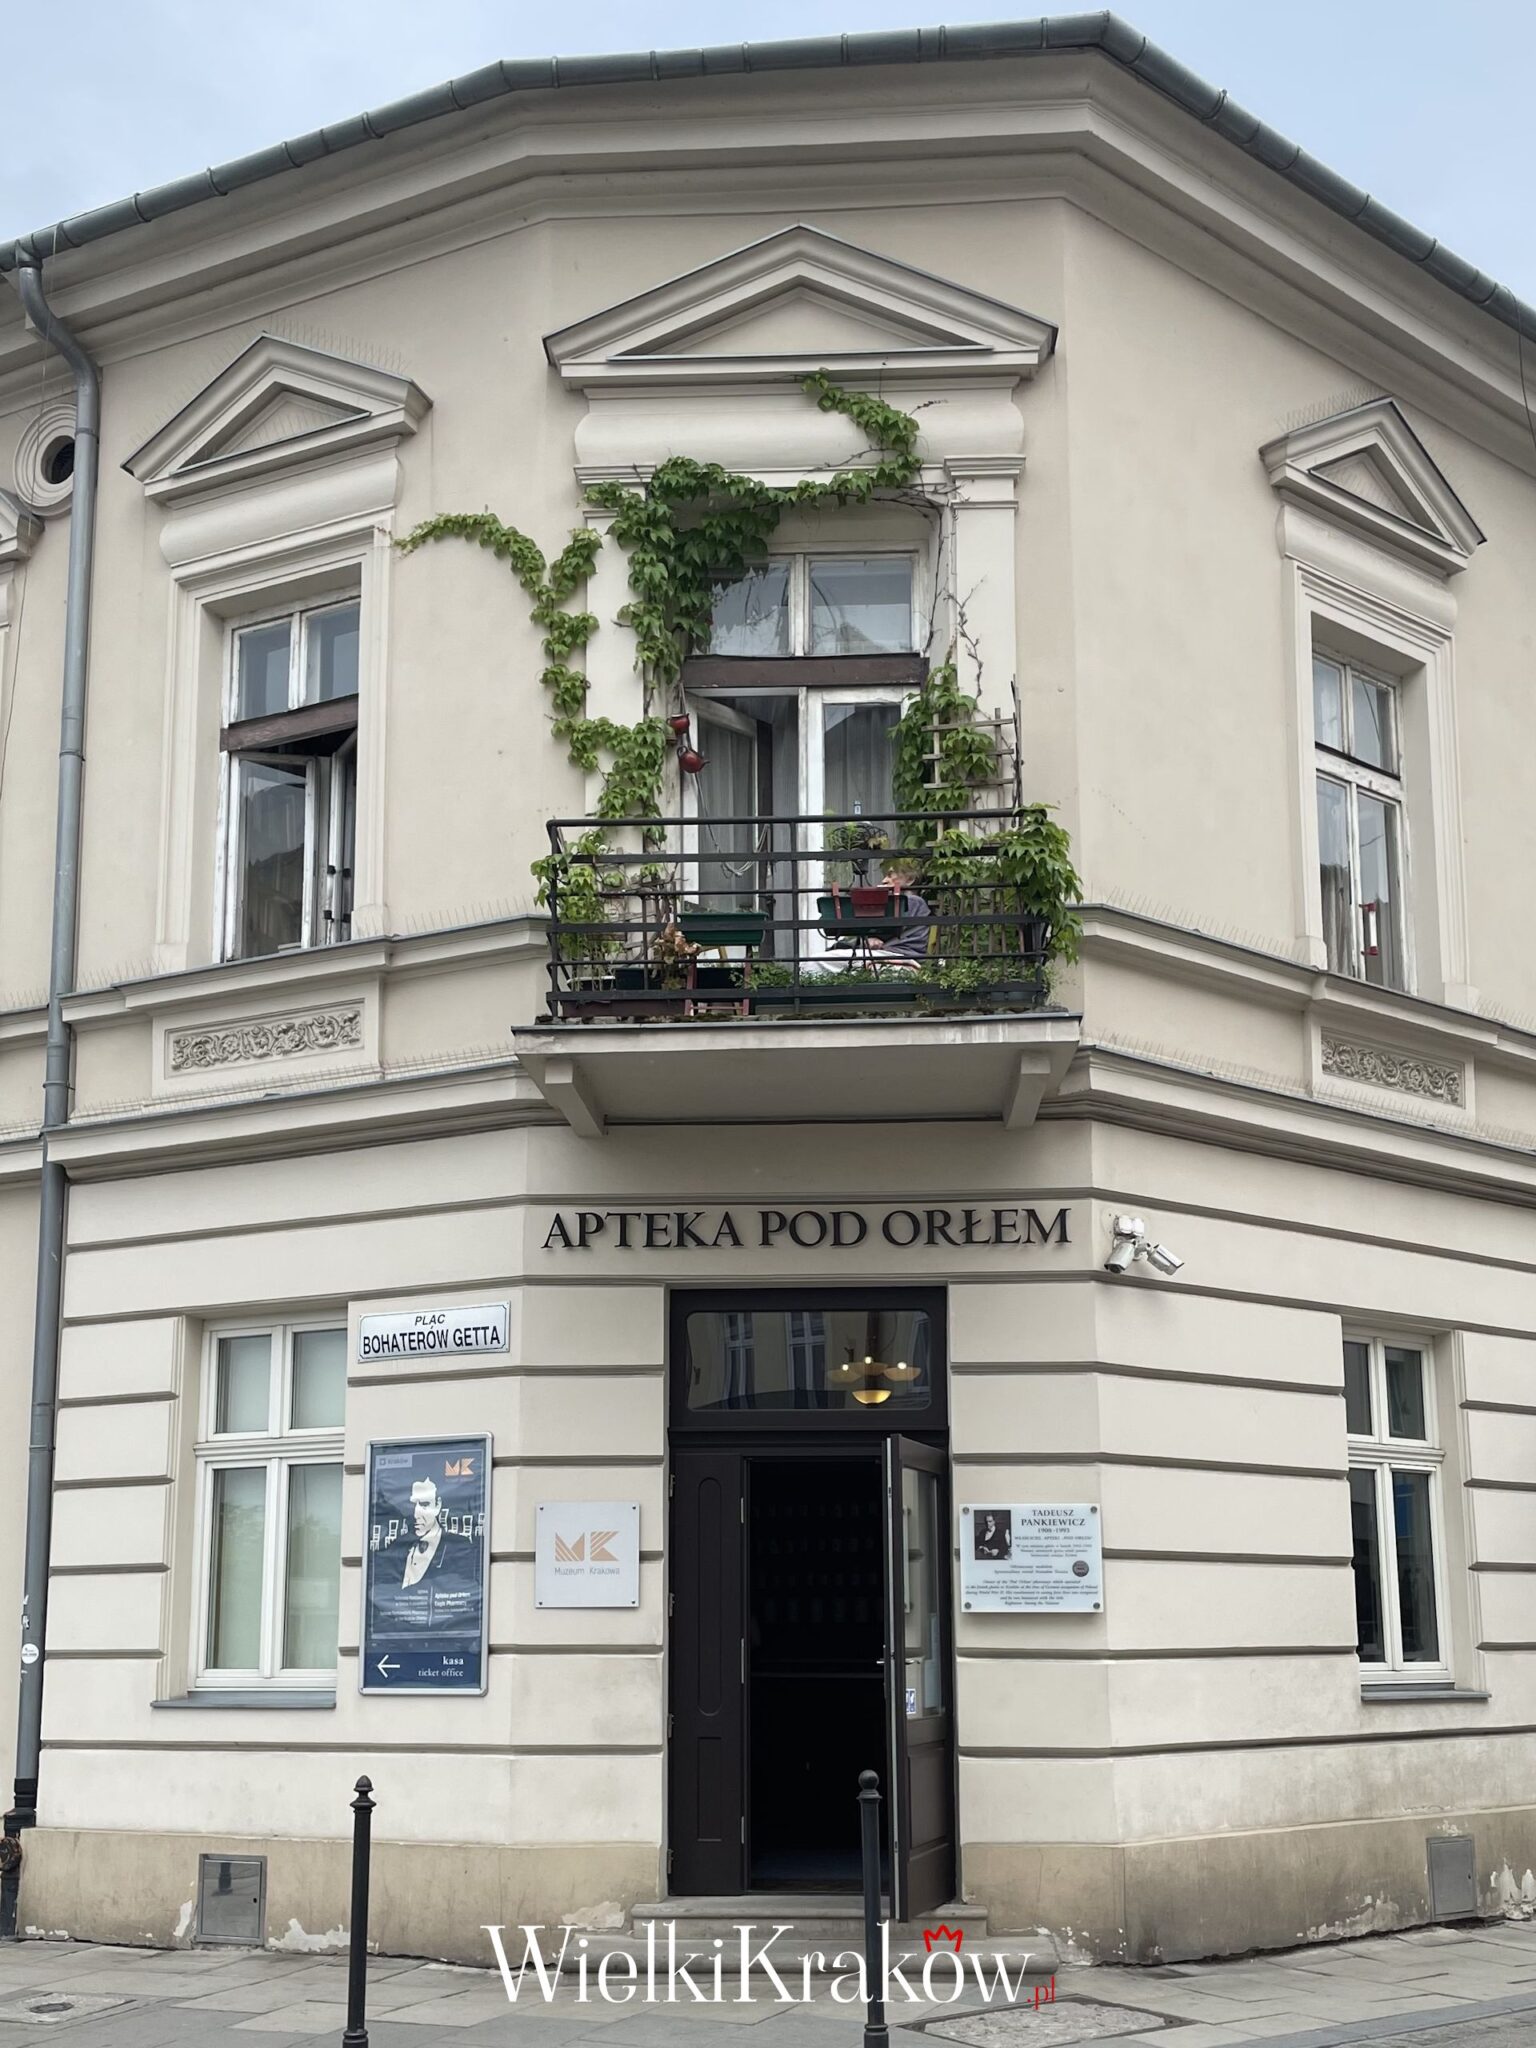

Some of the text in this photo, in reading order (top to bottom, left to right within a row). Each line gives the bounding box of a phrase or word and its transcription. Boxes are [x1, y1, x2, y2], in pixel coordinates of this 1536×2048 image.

[541, 1208, 1072, 1249] APTEKA POD ORŁEM
[414, 1314, 446, 1326] PLAC
[363, 1326, 501, 1355] BOHATERÓW GETTA
[1032, 1509, 1074, 1517] TADEUSZ
[1021, 1518, 1086, 1526] PANKIEWICZ
[554, 1567, 620, 1575] Muzeum Krakowa
[442, 1655, 464, 1665] kasa
[418, 1667, 464, 1677] ticket office
